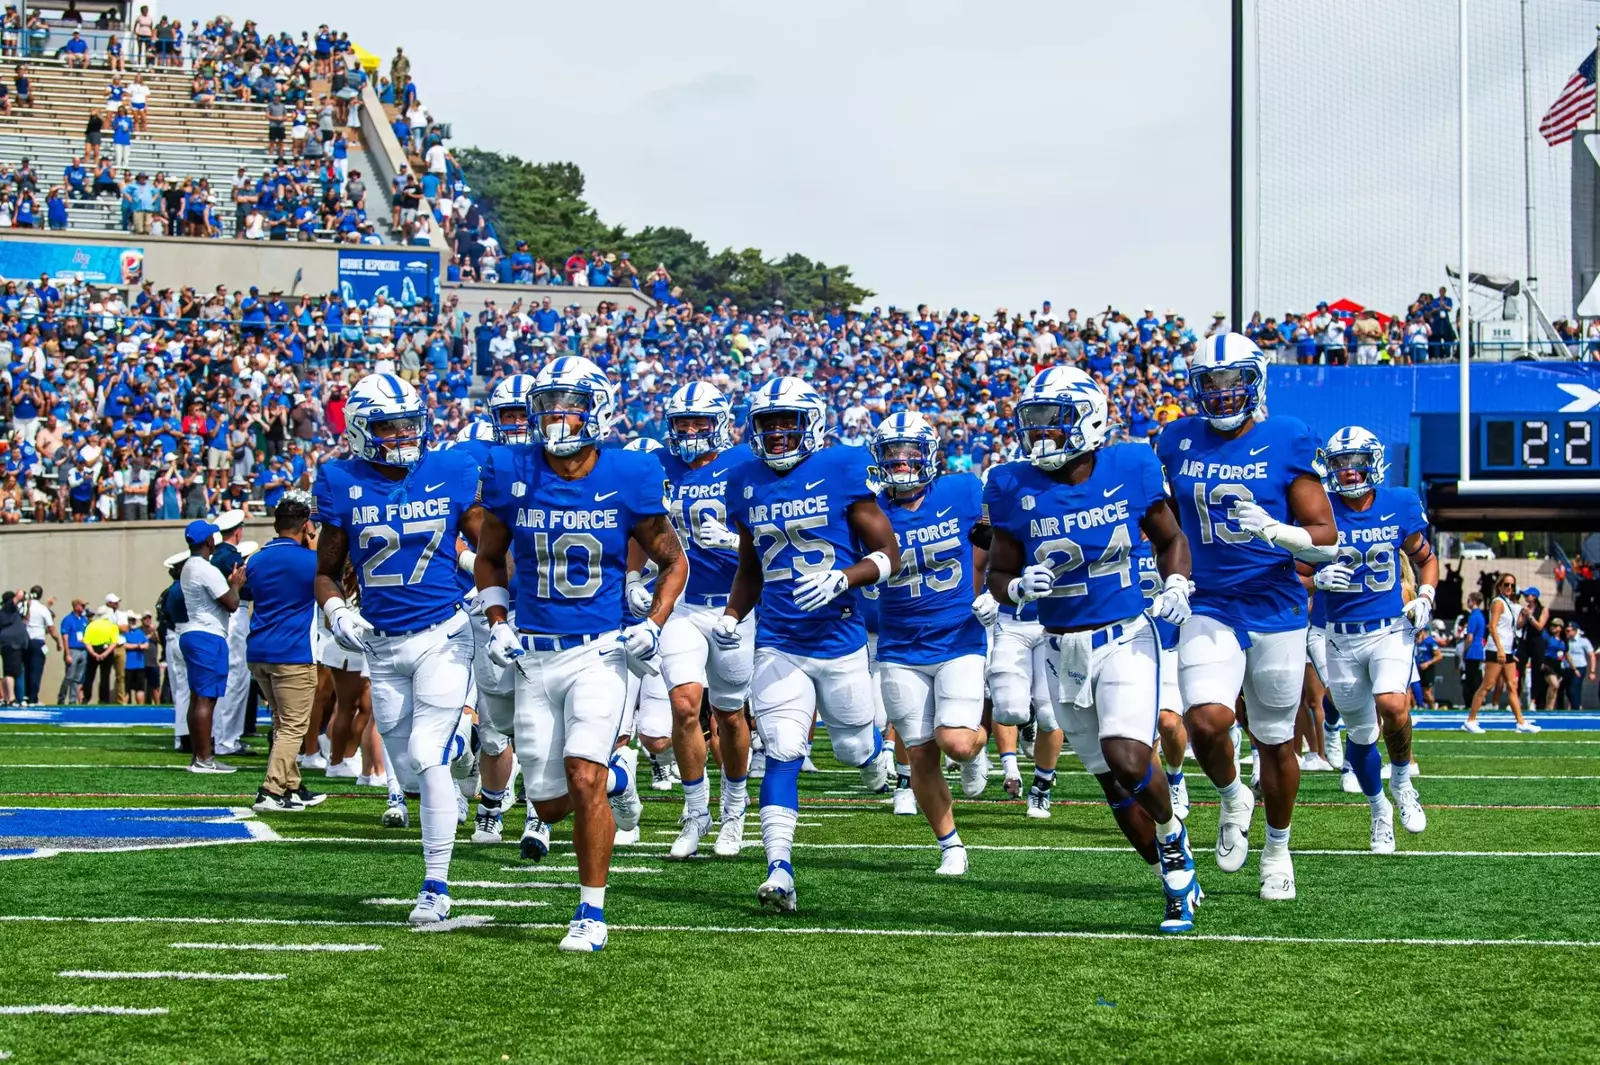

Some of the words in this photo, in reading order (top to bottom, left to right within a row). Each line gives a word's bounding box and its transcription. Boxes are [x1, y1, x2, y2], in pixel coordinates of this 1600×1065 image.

[1179, 459, 1204, 478] AIR
[1207, 461, 1268, 480] FORCE
[678, 481, 728, 499] FORCE
[749, 505, 768, 524] AIR
[771, 495, 829, 520] FORCE
[352, 506, 379, 525] AIR
[386, 497, 450, 522] FORCE
[516, 508, 545, 529] AIR
[549, 509, 618, 529] FORCE
[1030, 517, 1061, 538] AIR
[1063, 499, 1130, 533] FORCE
[1194, 482, 1254, 544] 13
[753, 514, 836, 582] 25
[905, 518, 960, 545] FORCE
[1351, 525, 1399, 543] FORCE
[359, 518, 447, 587] 27
[534, 532, 603, 598] 10
[887, 536, 963, 598] 45
[1034, 523, 1132, 598] 24
[1330, 542, 1396, 592] 29
